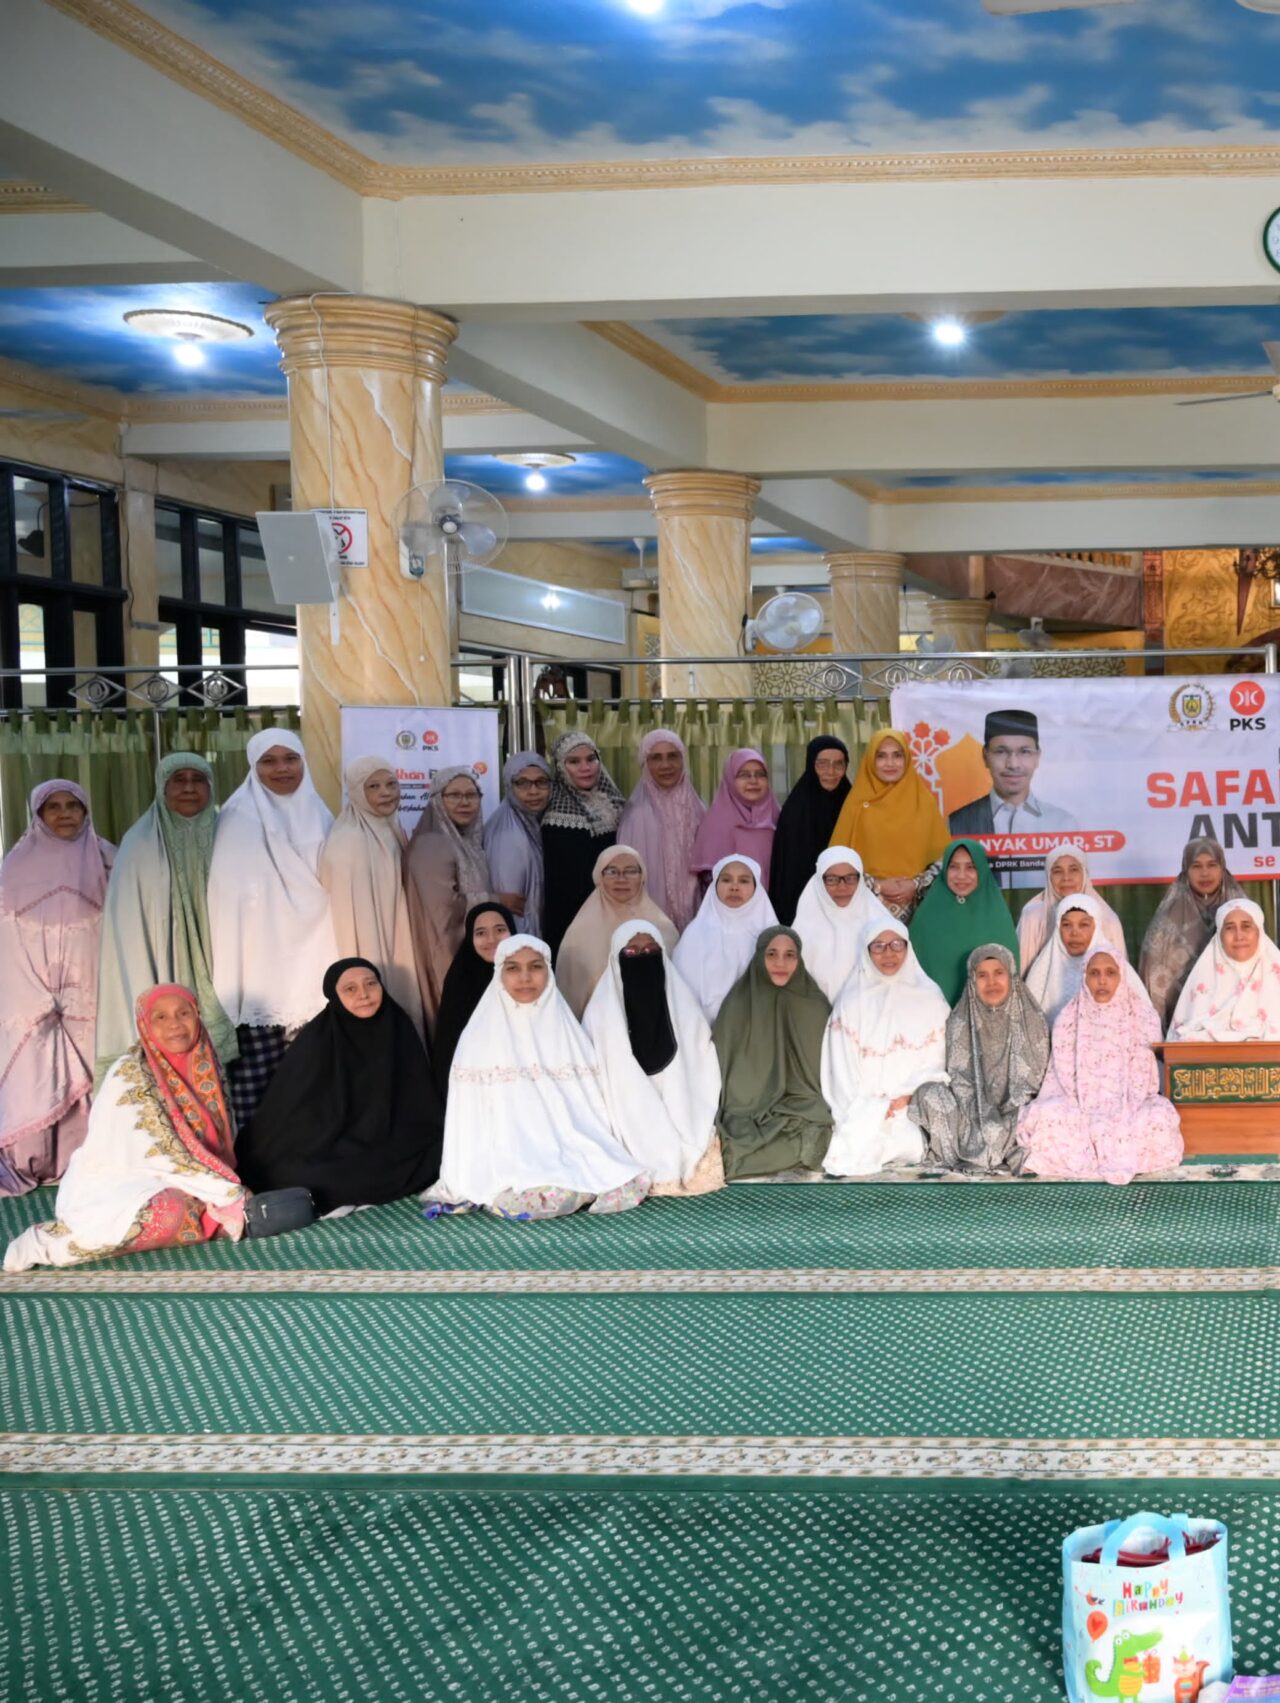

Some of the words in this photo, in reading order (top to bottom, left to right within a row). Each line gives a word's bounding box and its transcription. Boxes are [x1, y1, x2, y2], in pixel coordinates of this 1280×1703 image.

[1272, 236, 1279, 244] 9
[1229, 717, 1266, 732] PKS
[1094, 835, 1115, 848] ST
[995, 860, 1018, 868] DPRK
[1253, 855, 1276, 868] se
